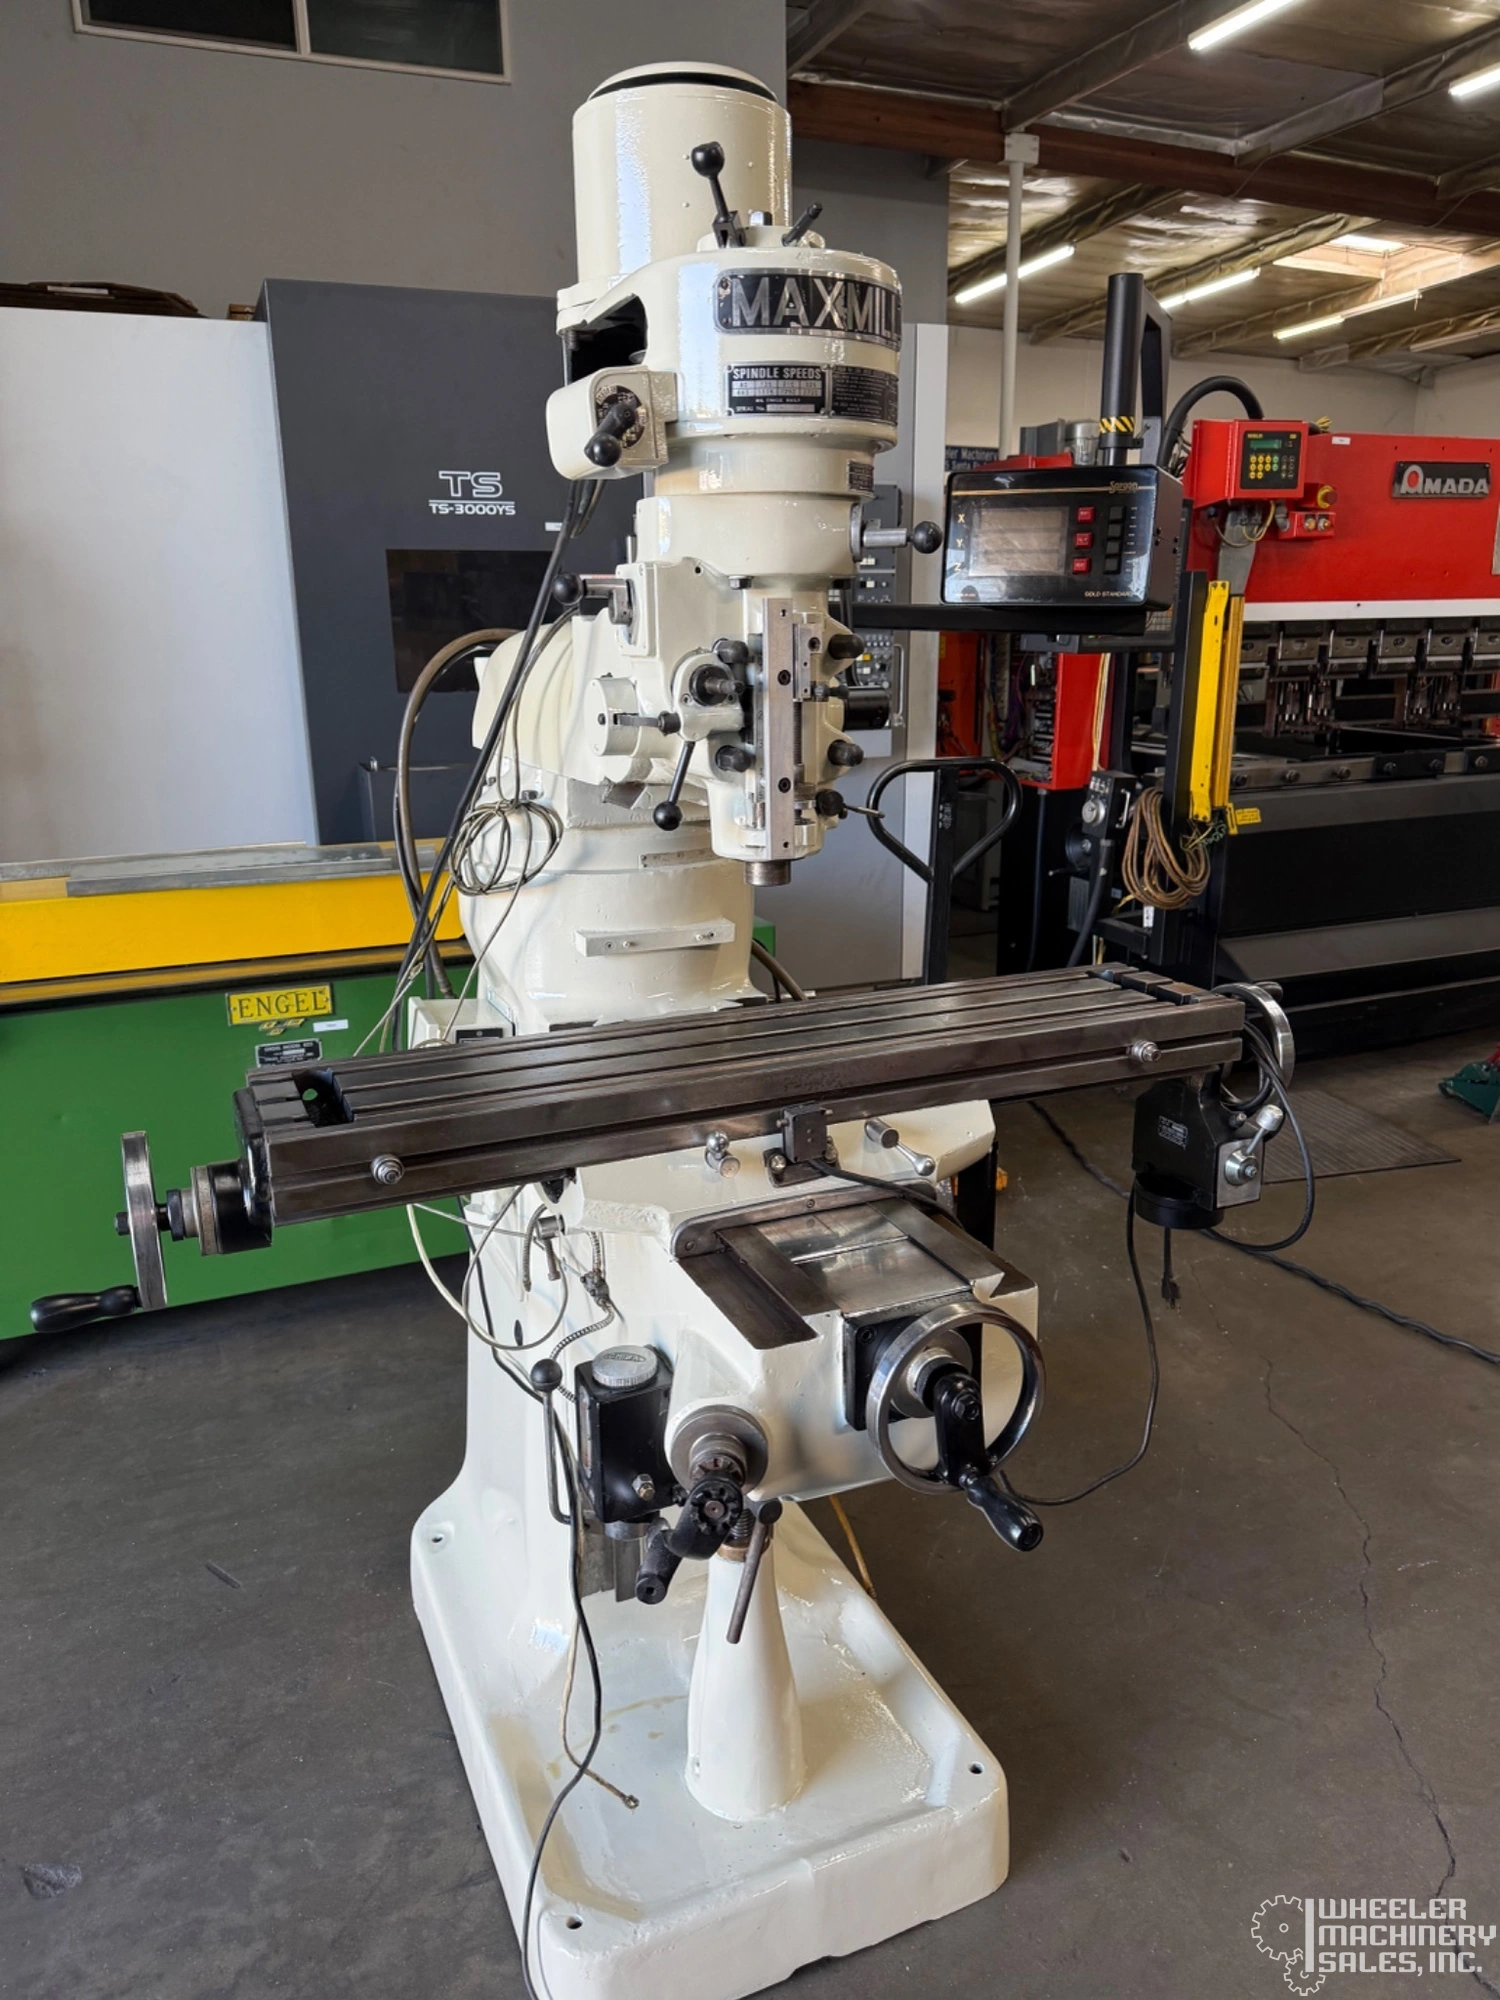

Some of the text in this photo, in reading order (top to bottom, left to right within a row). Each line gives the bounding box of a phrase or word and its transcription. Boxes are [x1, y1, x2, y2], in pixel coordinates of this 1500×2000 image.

[732, 276, 899, 341] MAXMILL
[732, 367, 822, 380] SPINDLE SPEEDS
[438, 470, 503, 498] TS
[1401, 464, 1489, 495] AMADA
[428, 503, 516, 516] TS-3000YS
[957, 513, 965, 523] X
[956, 538, 963, 547] Y
[954, 562, 961, 571] Z
[238, 991, 327, 1019] ENGEL
